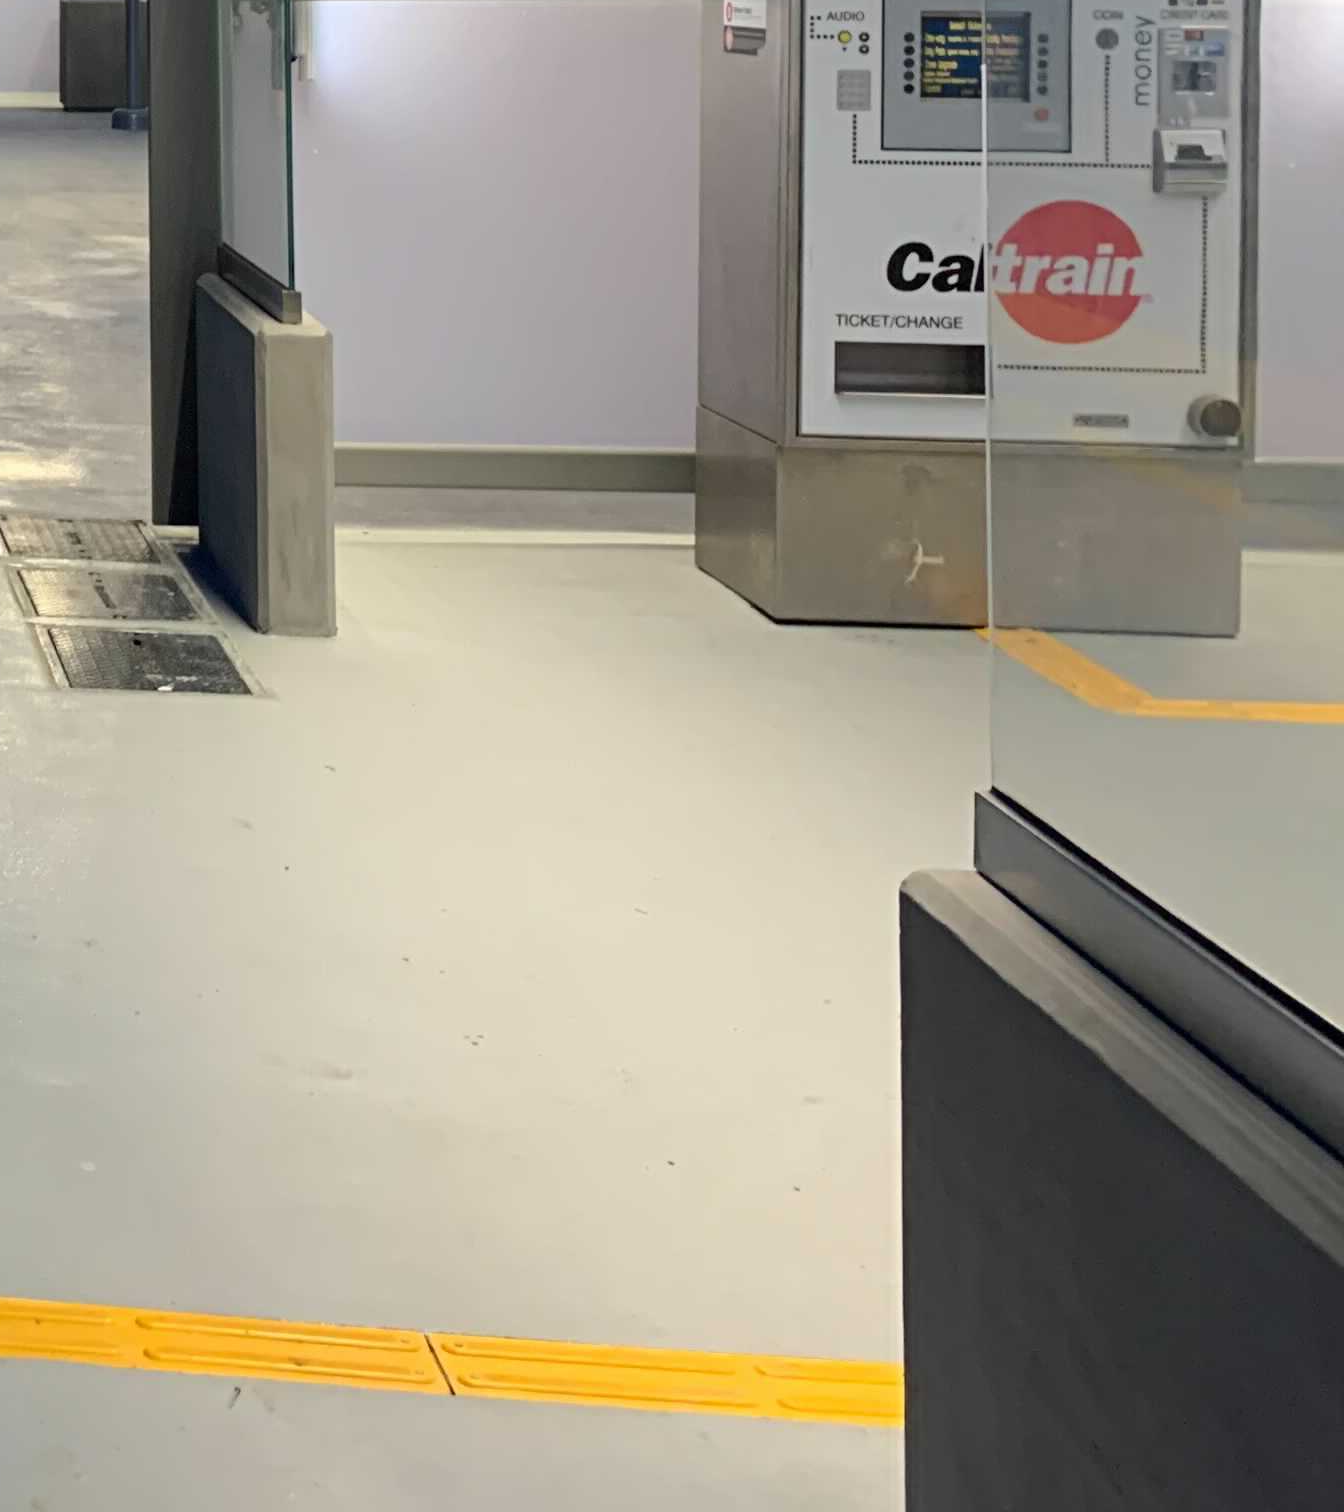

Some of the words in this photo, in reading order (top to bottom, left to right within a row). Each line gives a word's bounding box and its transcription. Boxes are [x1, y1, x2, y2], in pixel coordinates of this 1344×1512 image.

[826, 11, 865, 21] AUDIO
[1135, 15, 1157, 106] money
[886, 241, 1152, 297] Caltrain
[835, 314, 963, 330] TICKET/CHANGE
